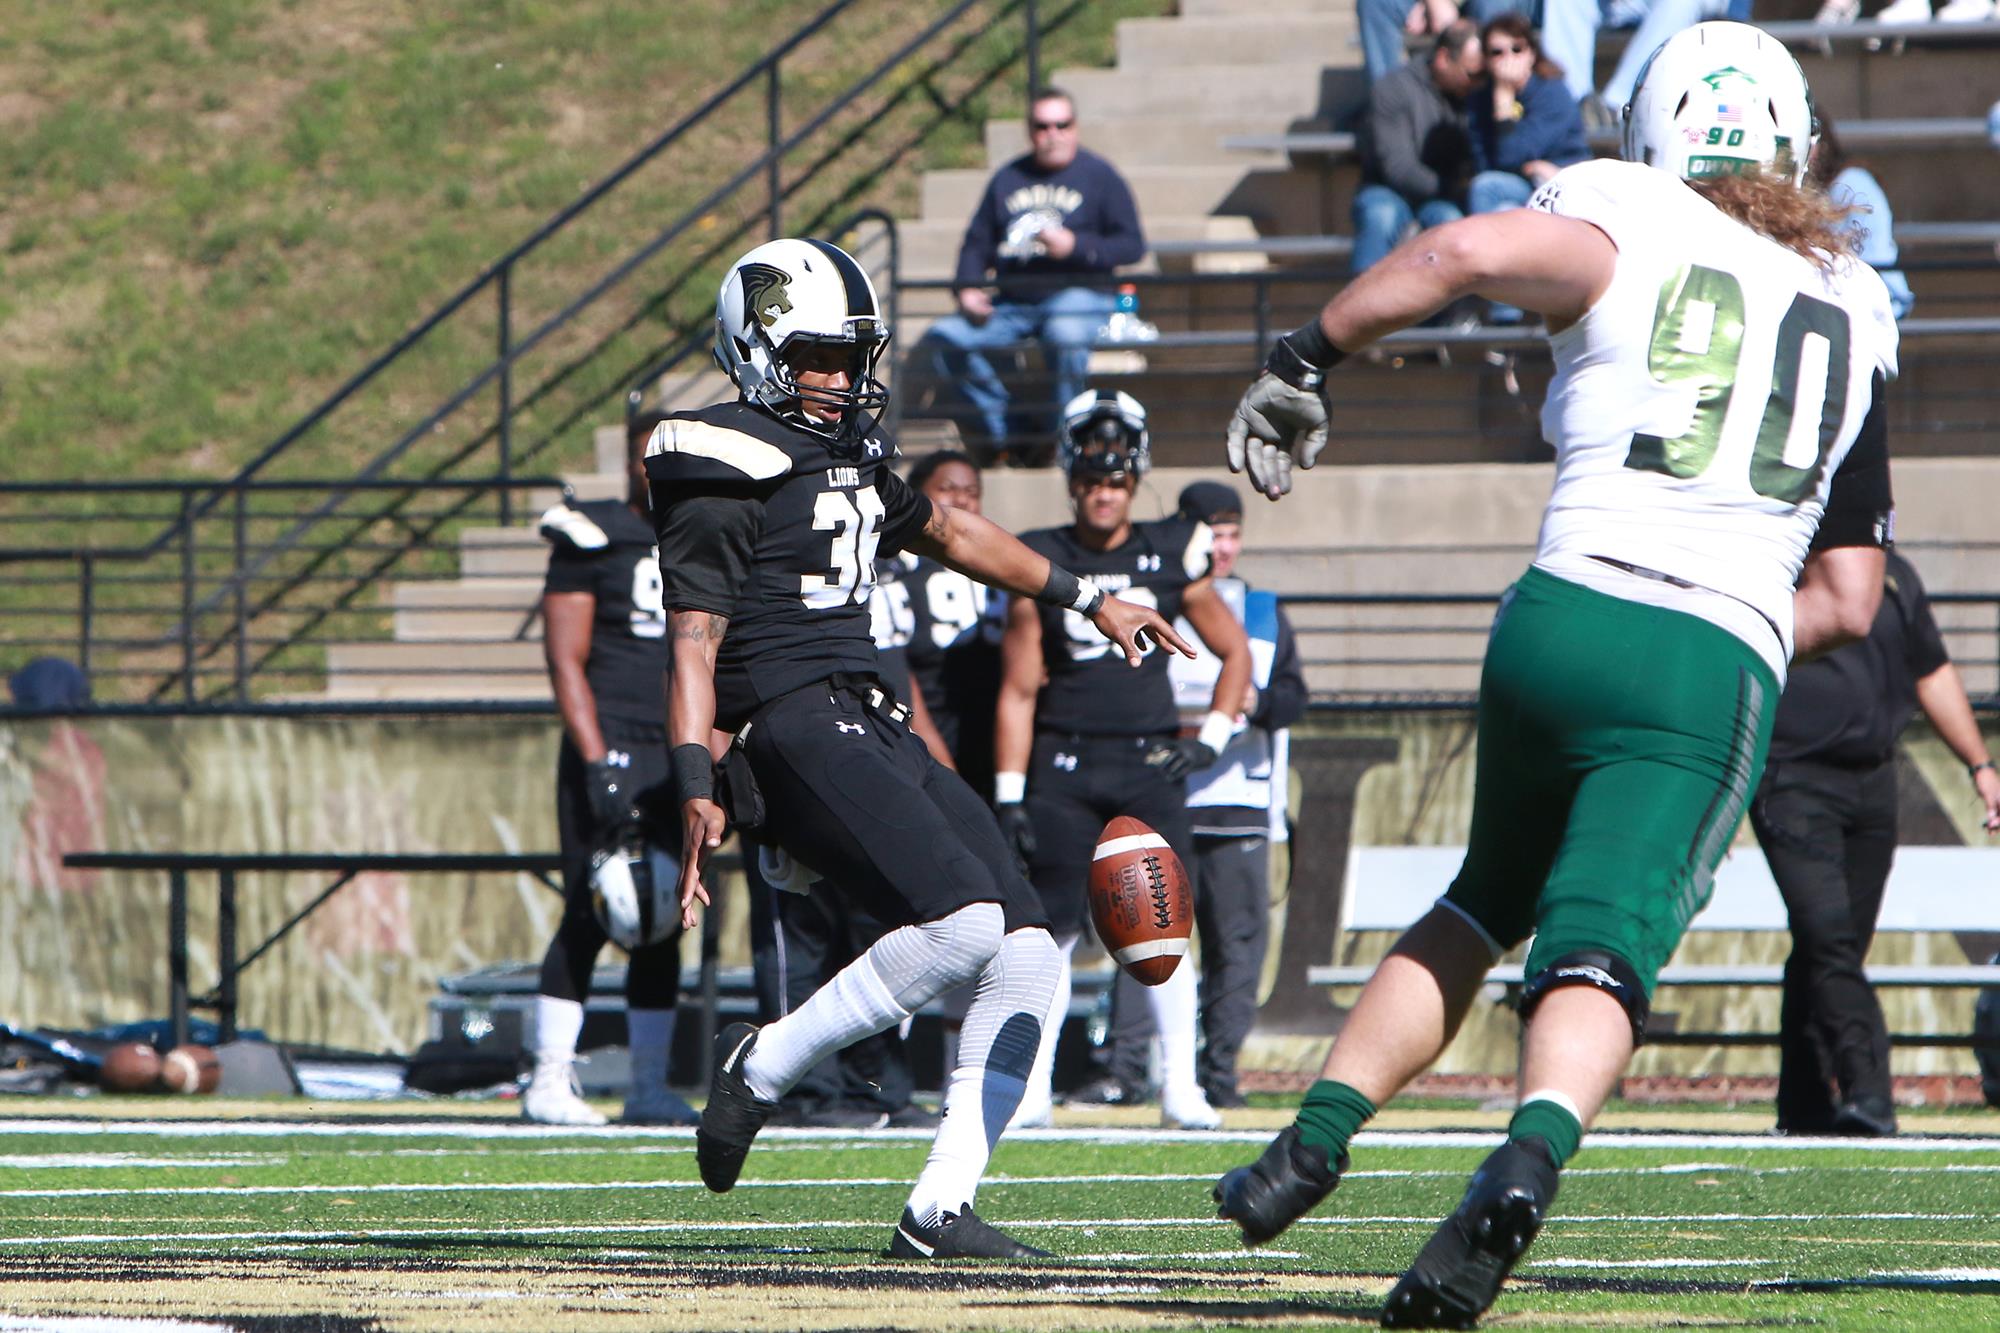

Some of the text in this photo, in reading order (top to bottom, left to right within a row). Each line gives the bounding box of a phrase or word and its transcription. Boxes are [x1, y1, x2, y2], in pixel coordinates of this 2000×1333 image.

[1706, 127, 1745, 146] 90
[1624, 264, 1850, 505] 90
[826, 467, 860, 487] LIONS
[801, 485, 886, 609] 36
